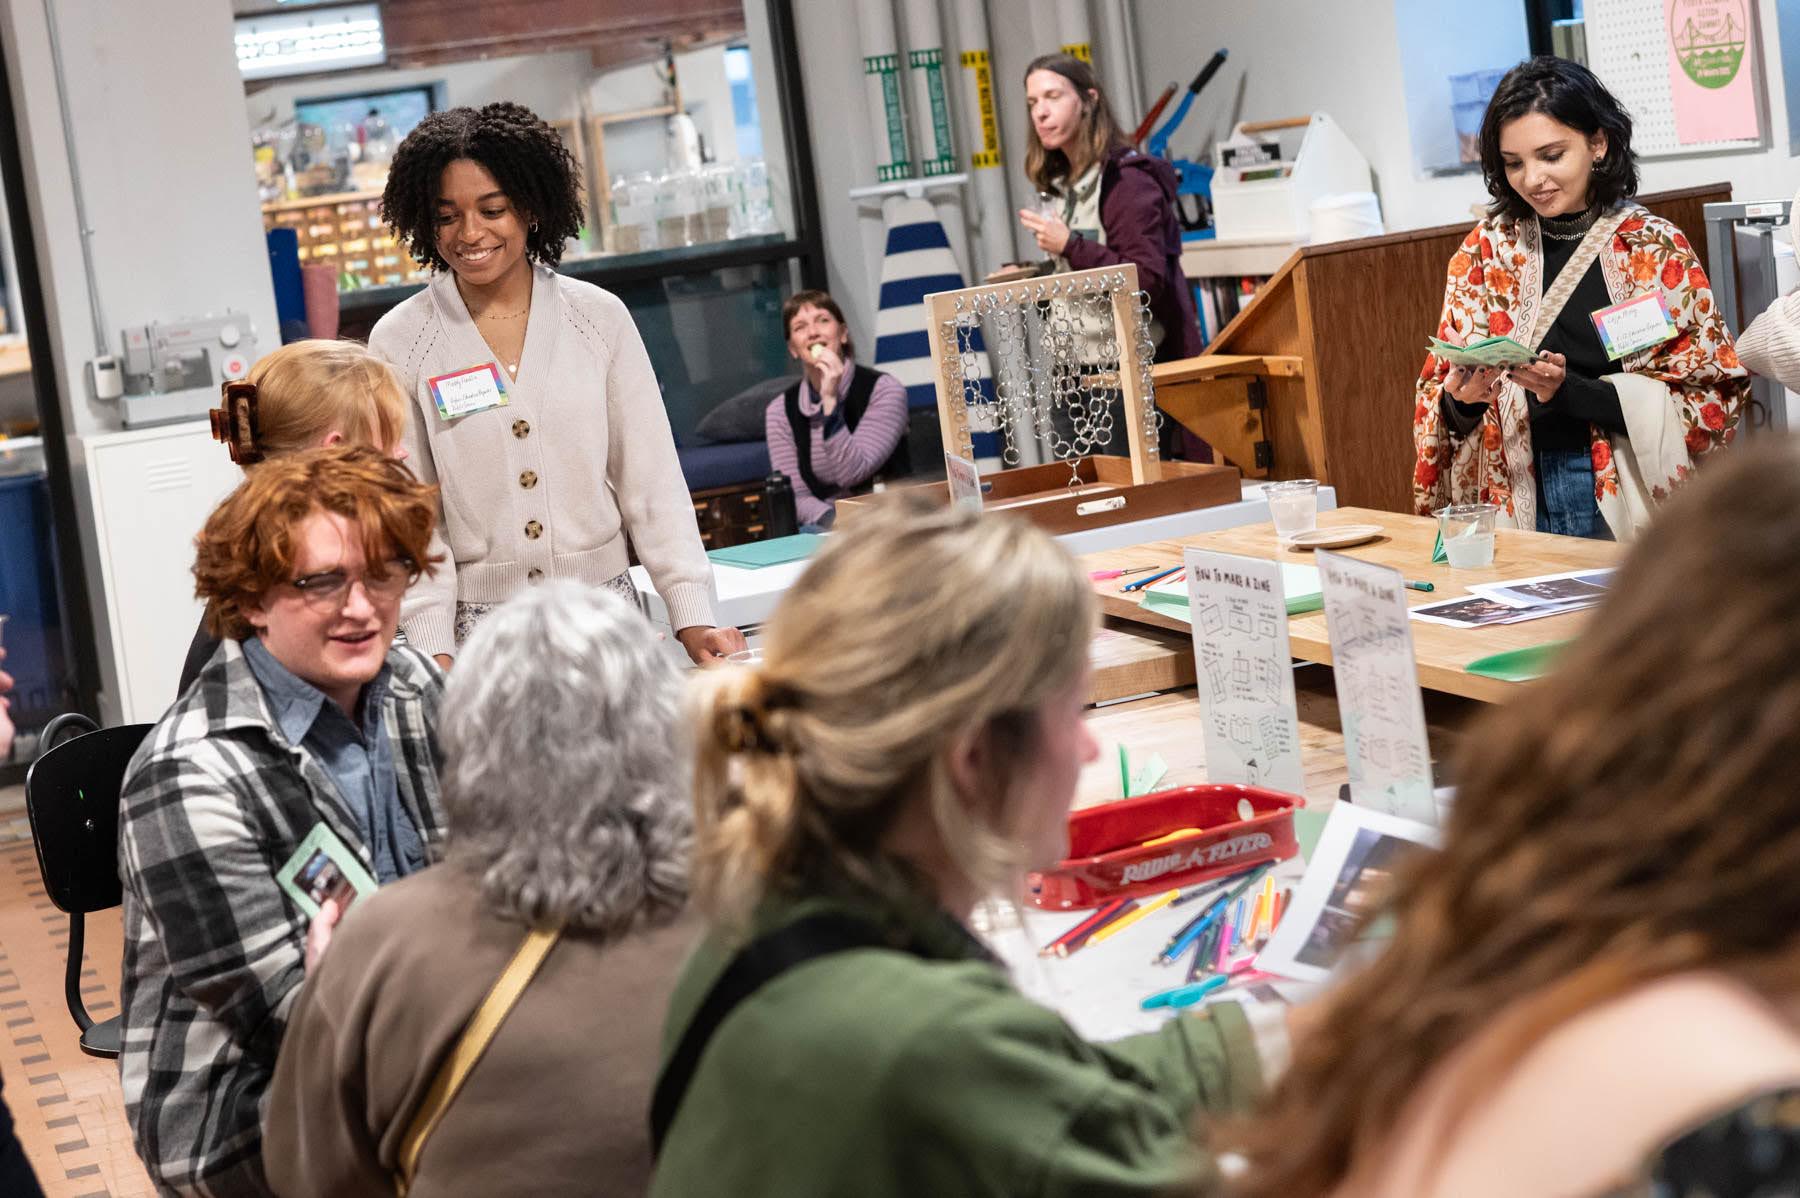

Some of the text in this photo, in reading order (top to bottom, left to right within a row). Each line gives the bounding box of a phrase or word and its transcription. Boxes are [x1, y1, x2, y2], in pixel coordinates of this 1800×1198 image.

[1224, 573, 1243, 588] MAKE
[1245, 576, 1251, 588] A
[1206, 833, 1273, 863] FLYER
